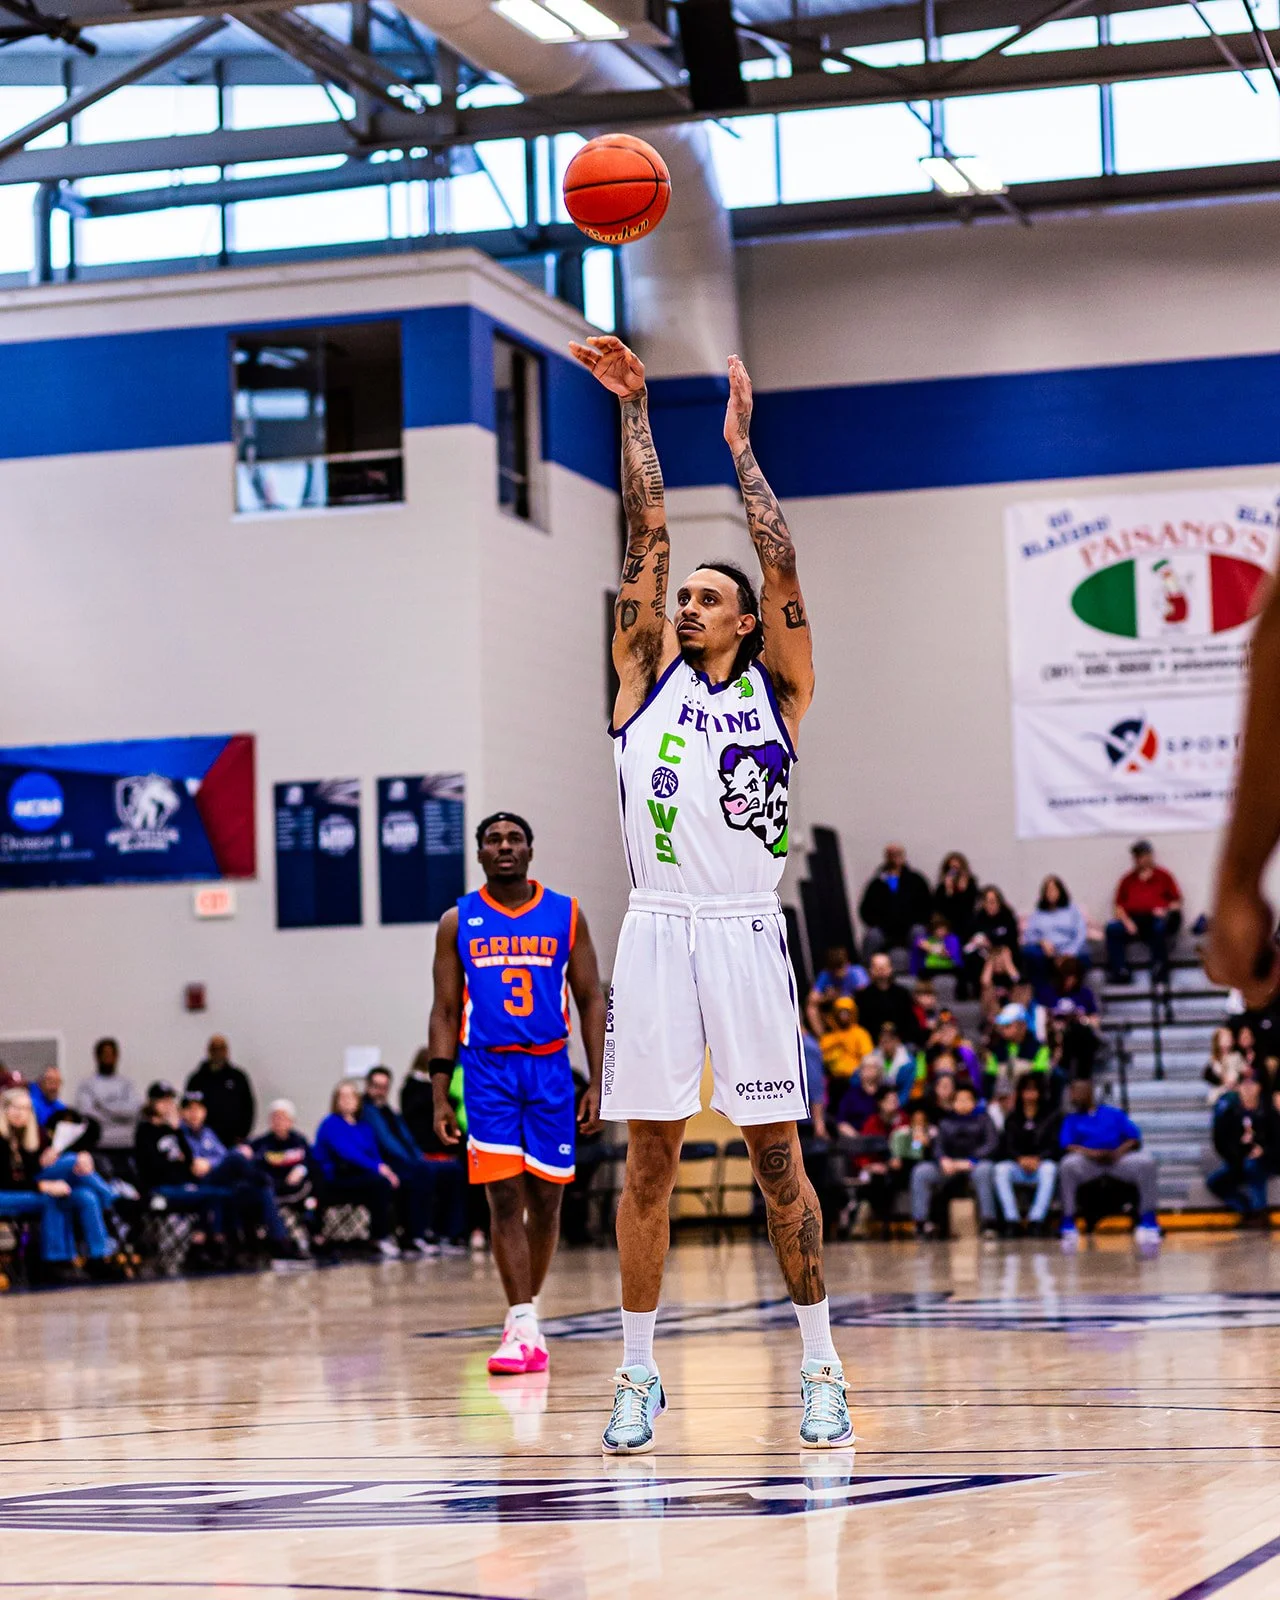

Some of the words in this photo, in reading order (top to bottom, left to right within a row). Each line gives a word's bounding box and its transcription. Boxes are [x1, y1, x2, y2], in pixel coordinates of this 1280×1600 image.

[1079, 521, 1268, 568] PAISANO'S
[469, 936, 558, 957] GRIND
[501, 968, 533, 1016] 3
[604, 1039, 616, 1096] FLYING
[745, 1093, 784, 1101] DESIGNS
